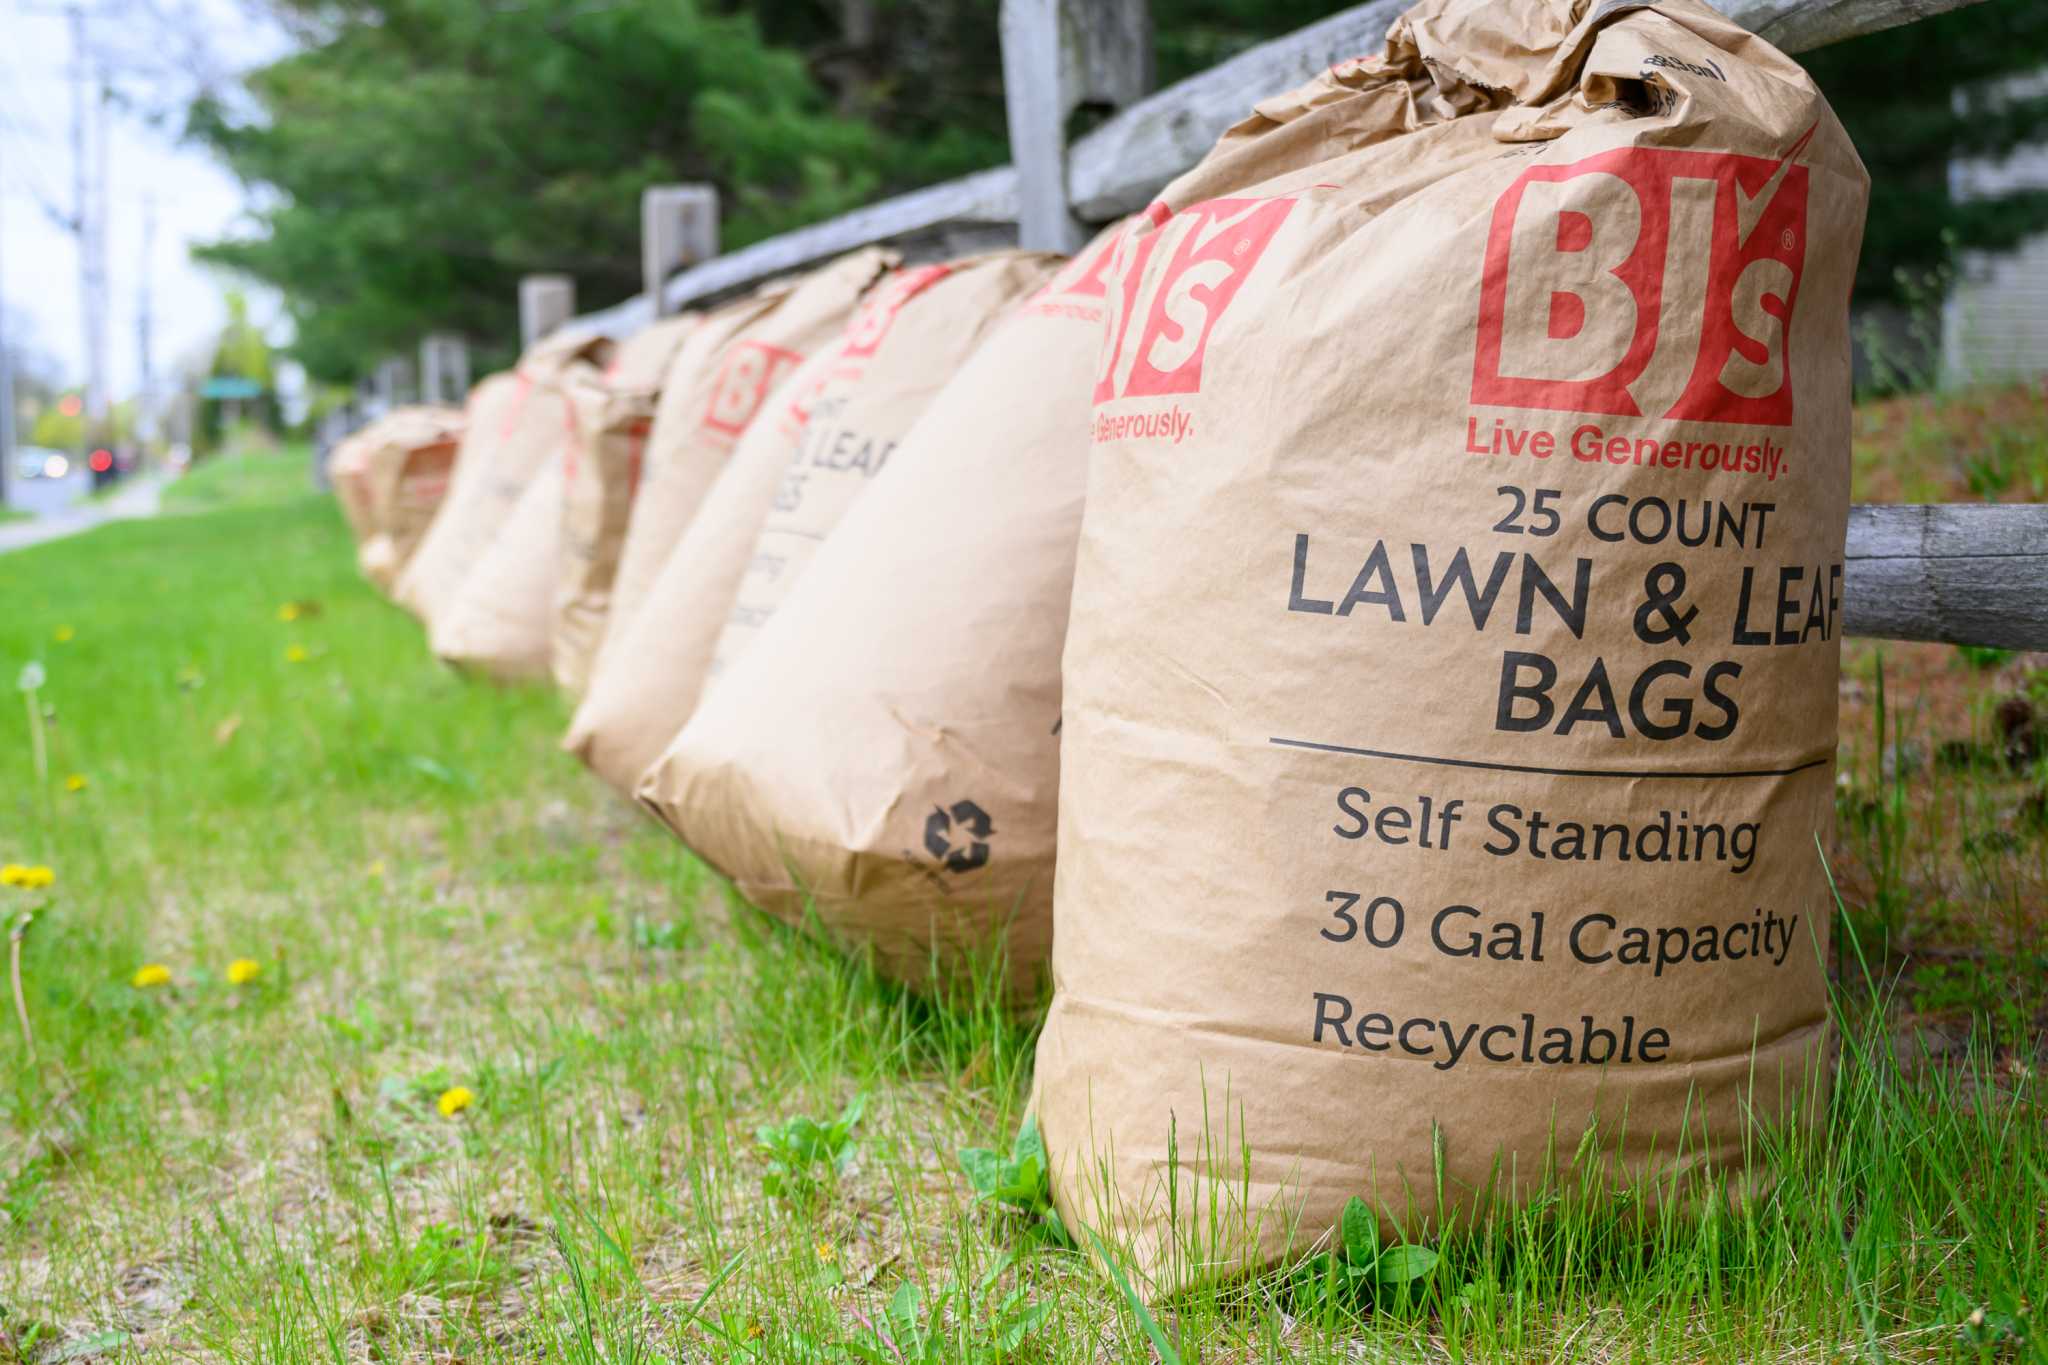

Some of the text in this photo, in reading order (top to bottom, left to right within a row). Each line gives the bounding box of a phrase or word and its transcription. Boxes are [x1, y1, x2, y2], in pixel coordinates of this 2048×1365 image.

[1097, 404, 1193, 444] Generously.
[1466, 415, 1789, 482] Live Generously.
[1492, 484, 1776, 550] 25 COUNT
[1286, 532, 1842, 648] LAWN & LEAF
[1494, 649, 1744, 743] BAGS
[1331, 785, 1762, 875] Self Standing
[1319, 889, 1799, 978] 30 Gal Capacity
[1311, 991, 1673, 1072] Recyclable
